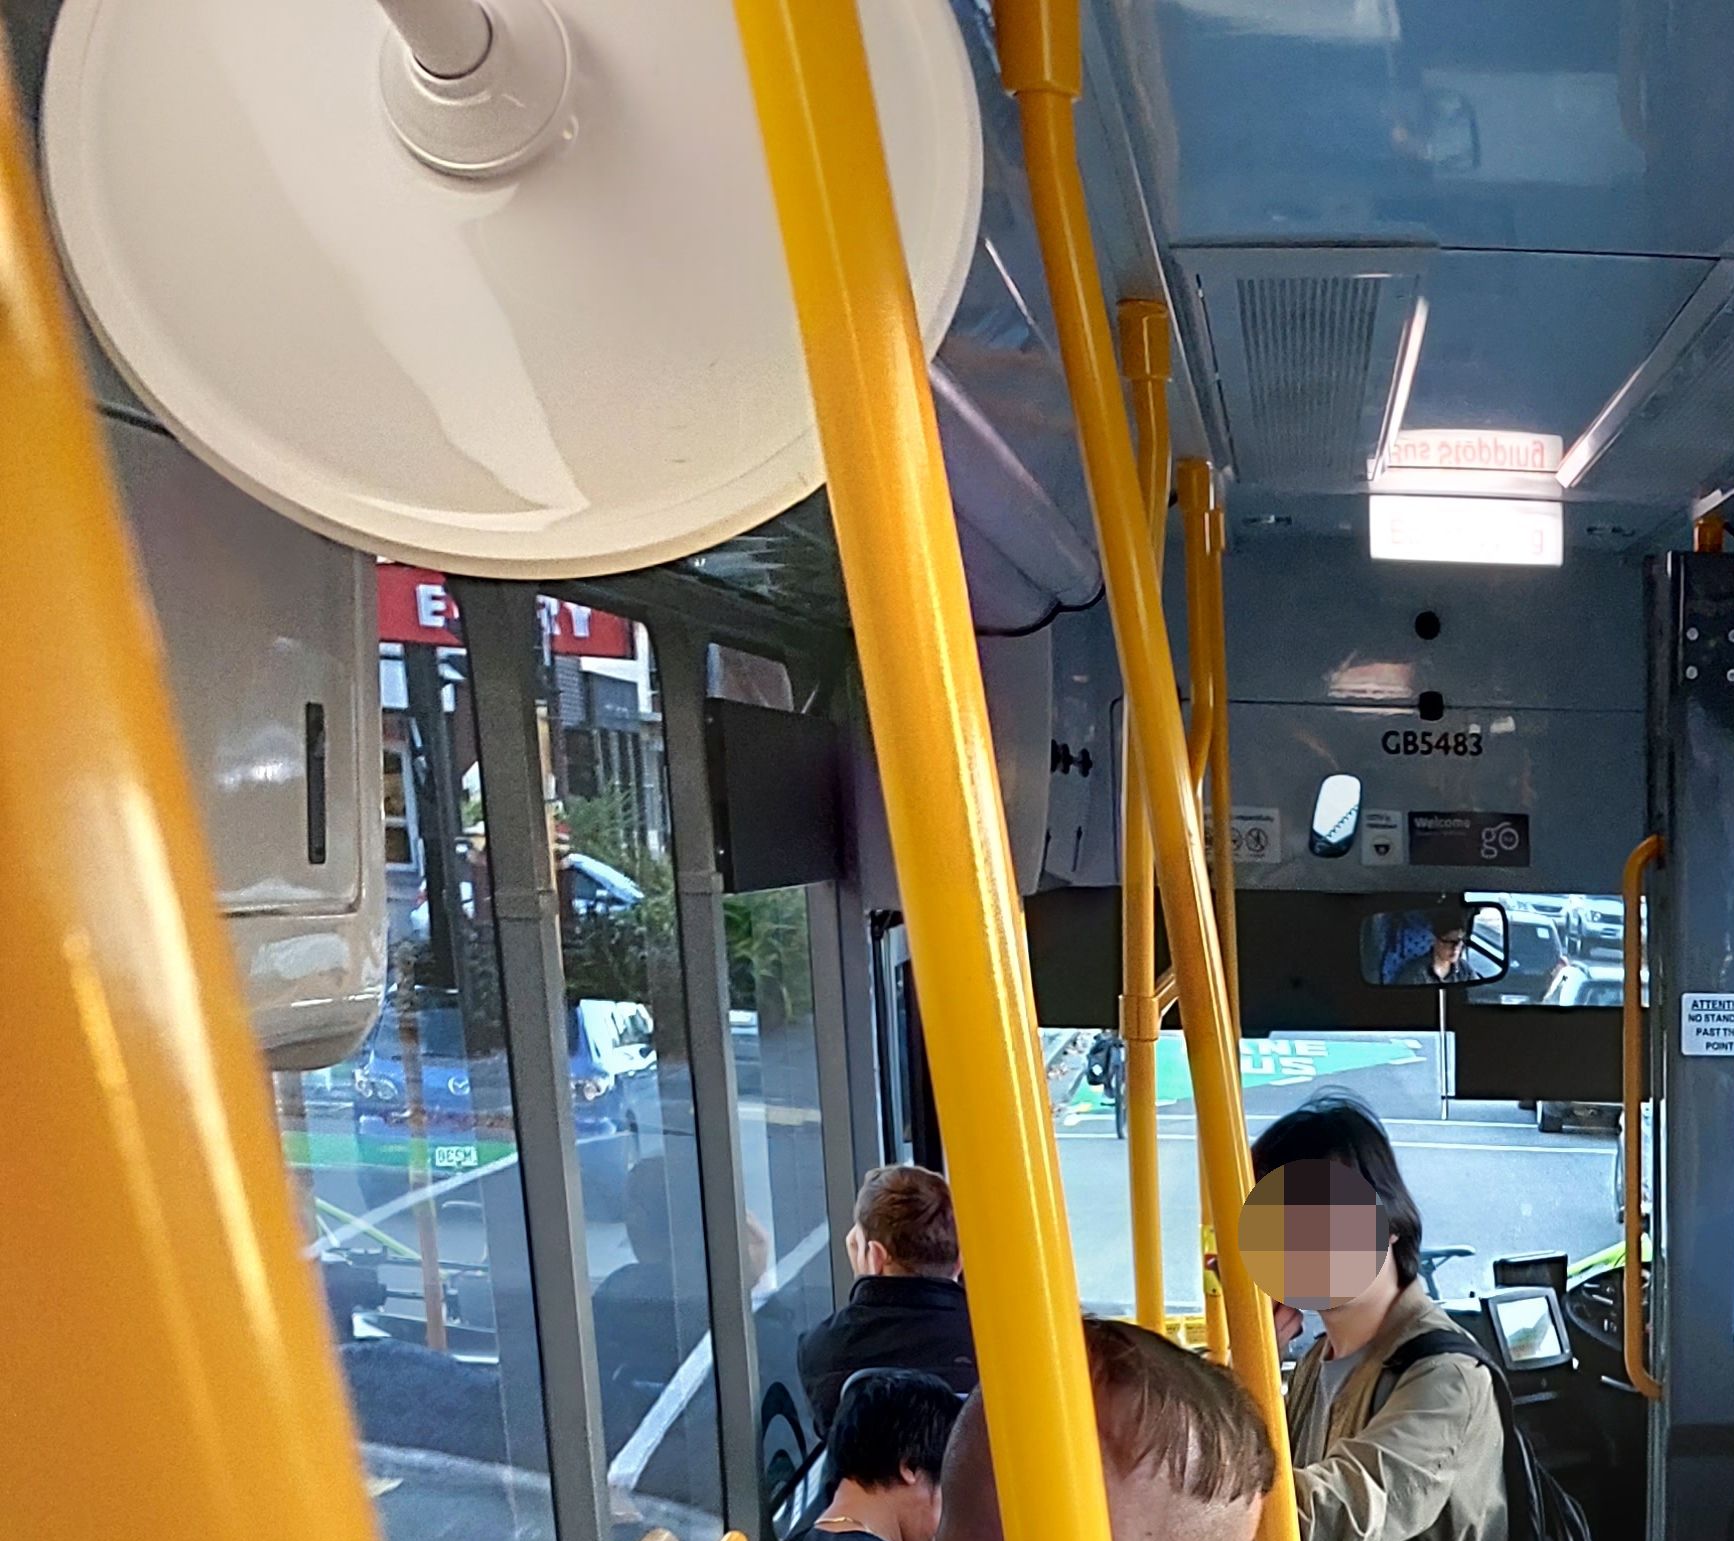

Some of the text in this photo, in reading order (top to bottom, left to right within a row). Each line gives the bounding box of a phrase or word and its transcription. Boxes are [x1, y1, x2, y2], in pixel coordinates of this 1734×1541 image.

[1381, 730, 1483, 756] GB5483
[1414, 816, 1471, 829] Welcome
[1688, 1014, 1702, 1022] NO
[1696, 1028, 1720, 1036] PAST
[1706, 1042, 1734, 1051] POINT
